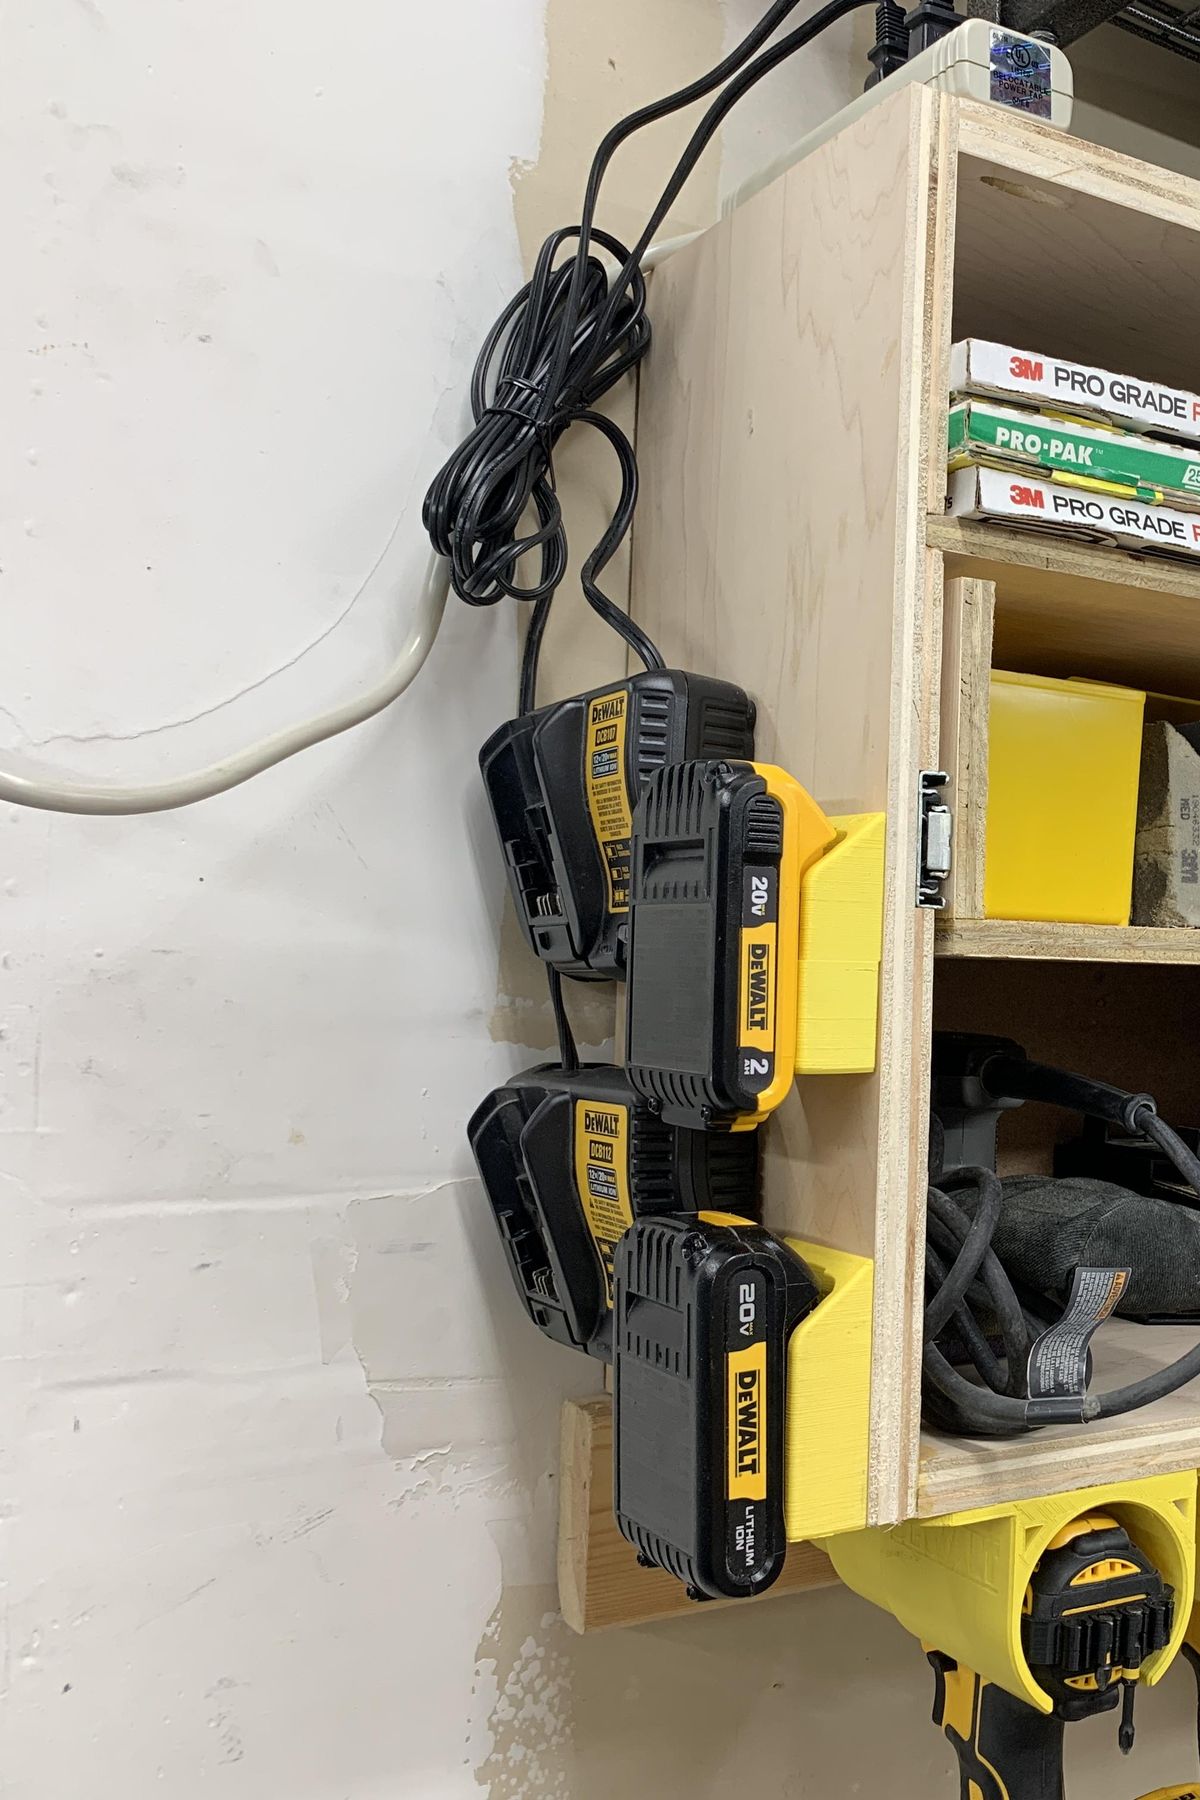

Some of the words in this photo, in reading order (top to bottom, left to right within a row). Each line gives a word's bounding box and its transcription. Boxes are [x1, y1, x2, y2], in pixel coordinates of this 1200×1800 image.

[1013, 46, 1028, 66] UL
[999, 80, 1026, 94] POWER
[1030, 89, 1043, 99] TAP
[1010, 356, 1043, 381] 3M
[1054, 366, 1105, 397] PRO
[1110, 380, 1187, 419] GRADE
[1010, 485, 1045, 509] 3M
[1053, 495, 1104, 520] PRO
[1109, 507, 1186, 540] GRADE
[596, 727, 616, 744] DCB107
[1180, 798, 1190, 820] MED
[1180, 850, 1199, 884] 3M
[752, 876, 768, 916] 20V
[749, 944, 767, 1030] DEWALT
[744, 1059, 750, 1075] AH
[750, 1058, 769, 1076] 2
[591, 1143, 612, 1160] DCB112
[739, 1283, 755, 1336] 20V
[738, 1370, 758, 1476] DEWALT
[735, 1525, 745, 1550] ION
[745, 1505, 754, 1566] LITHIUM
